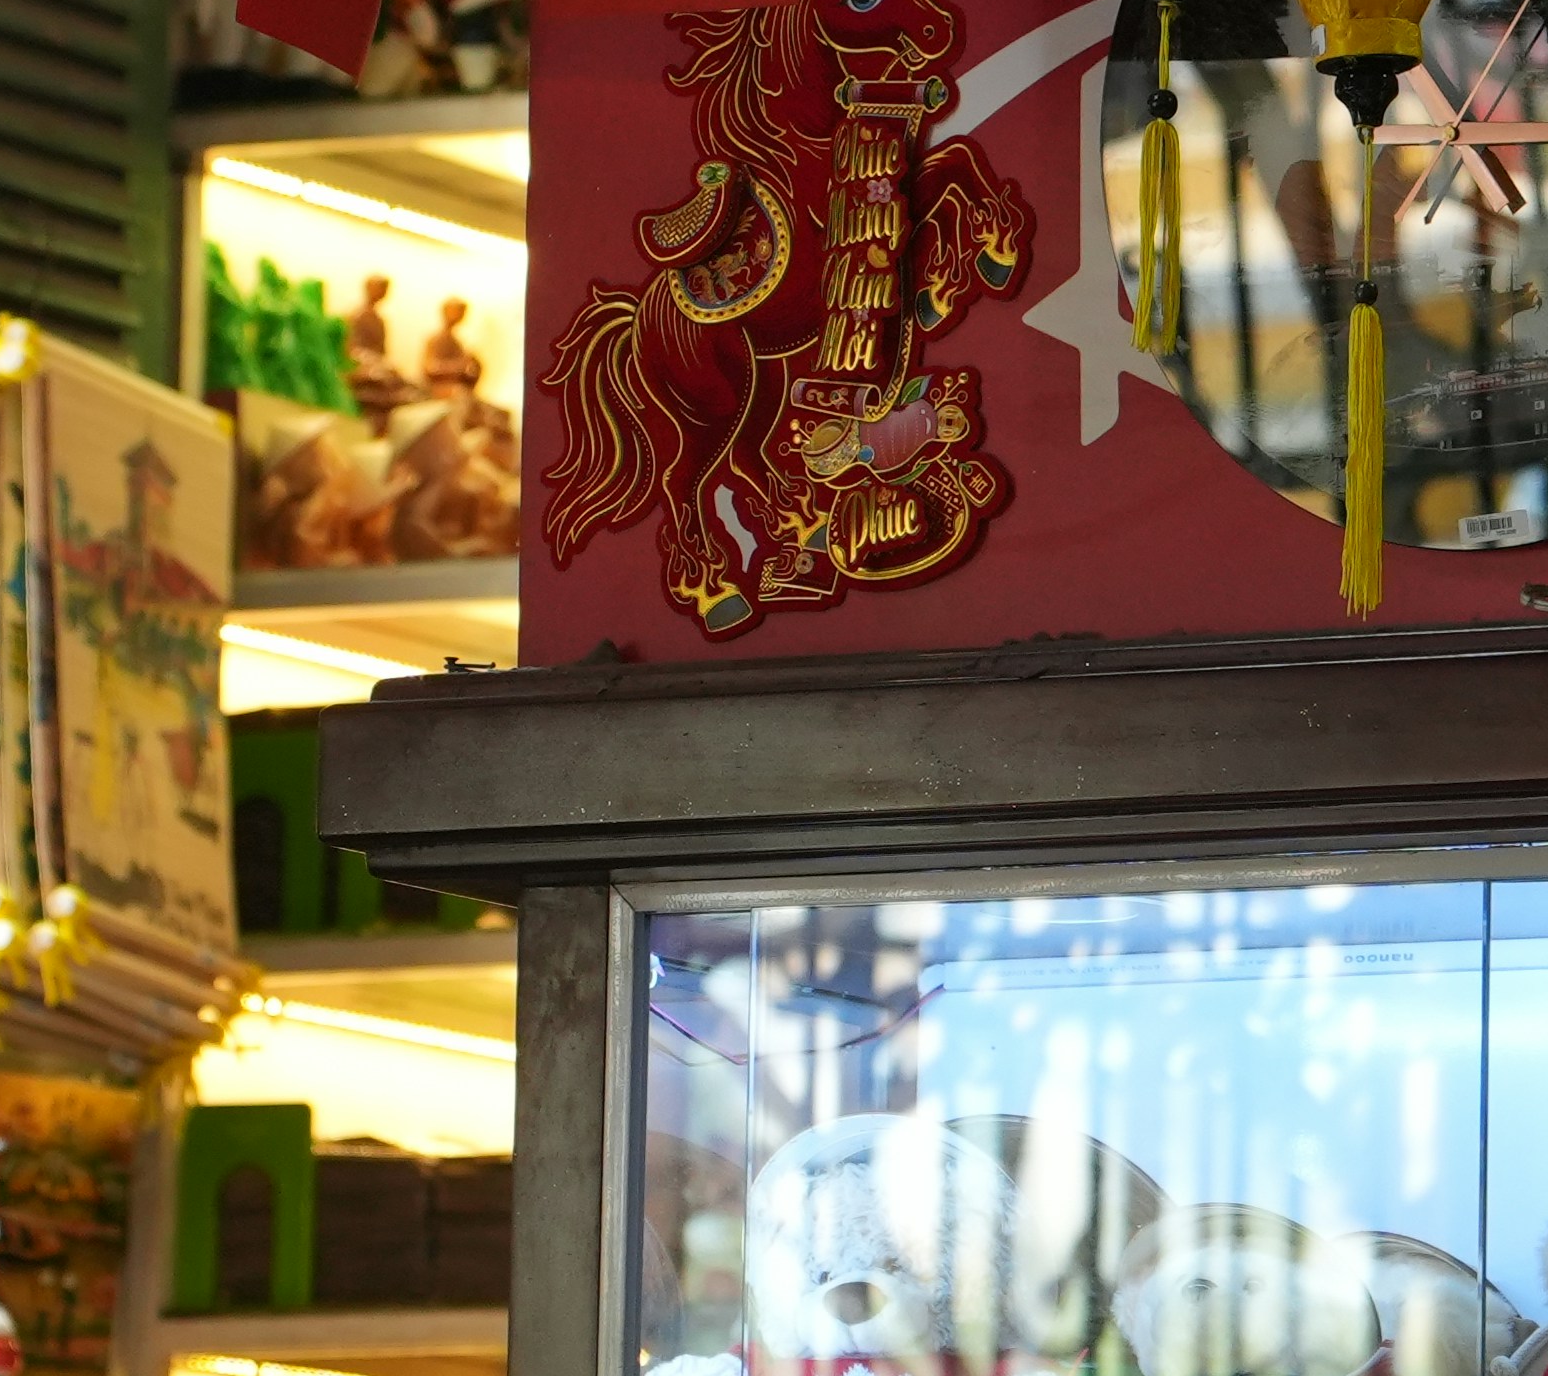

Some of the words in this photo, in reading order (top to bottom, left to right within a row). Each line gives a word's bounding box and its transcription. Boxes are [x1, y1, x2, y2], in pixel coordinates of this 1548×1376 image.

[833, 123, 901, 184] Chúc
[823, 186, 906, 253] Mừng
[821, 252, 895, 312] Năm
[811, 318, 878, 374] Mới
[843, 488, 921, 563] Phúc
